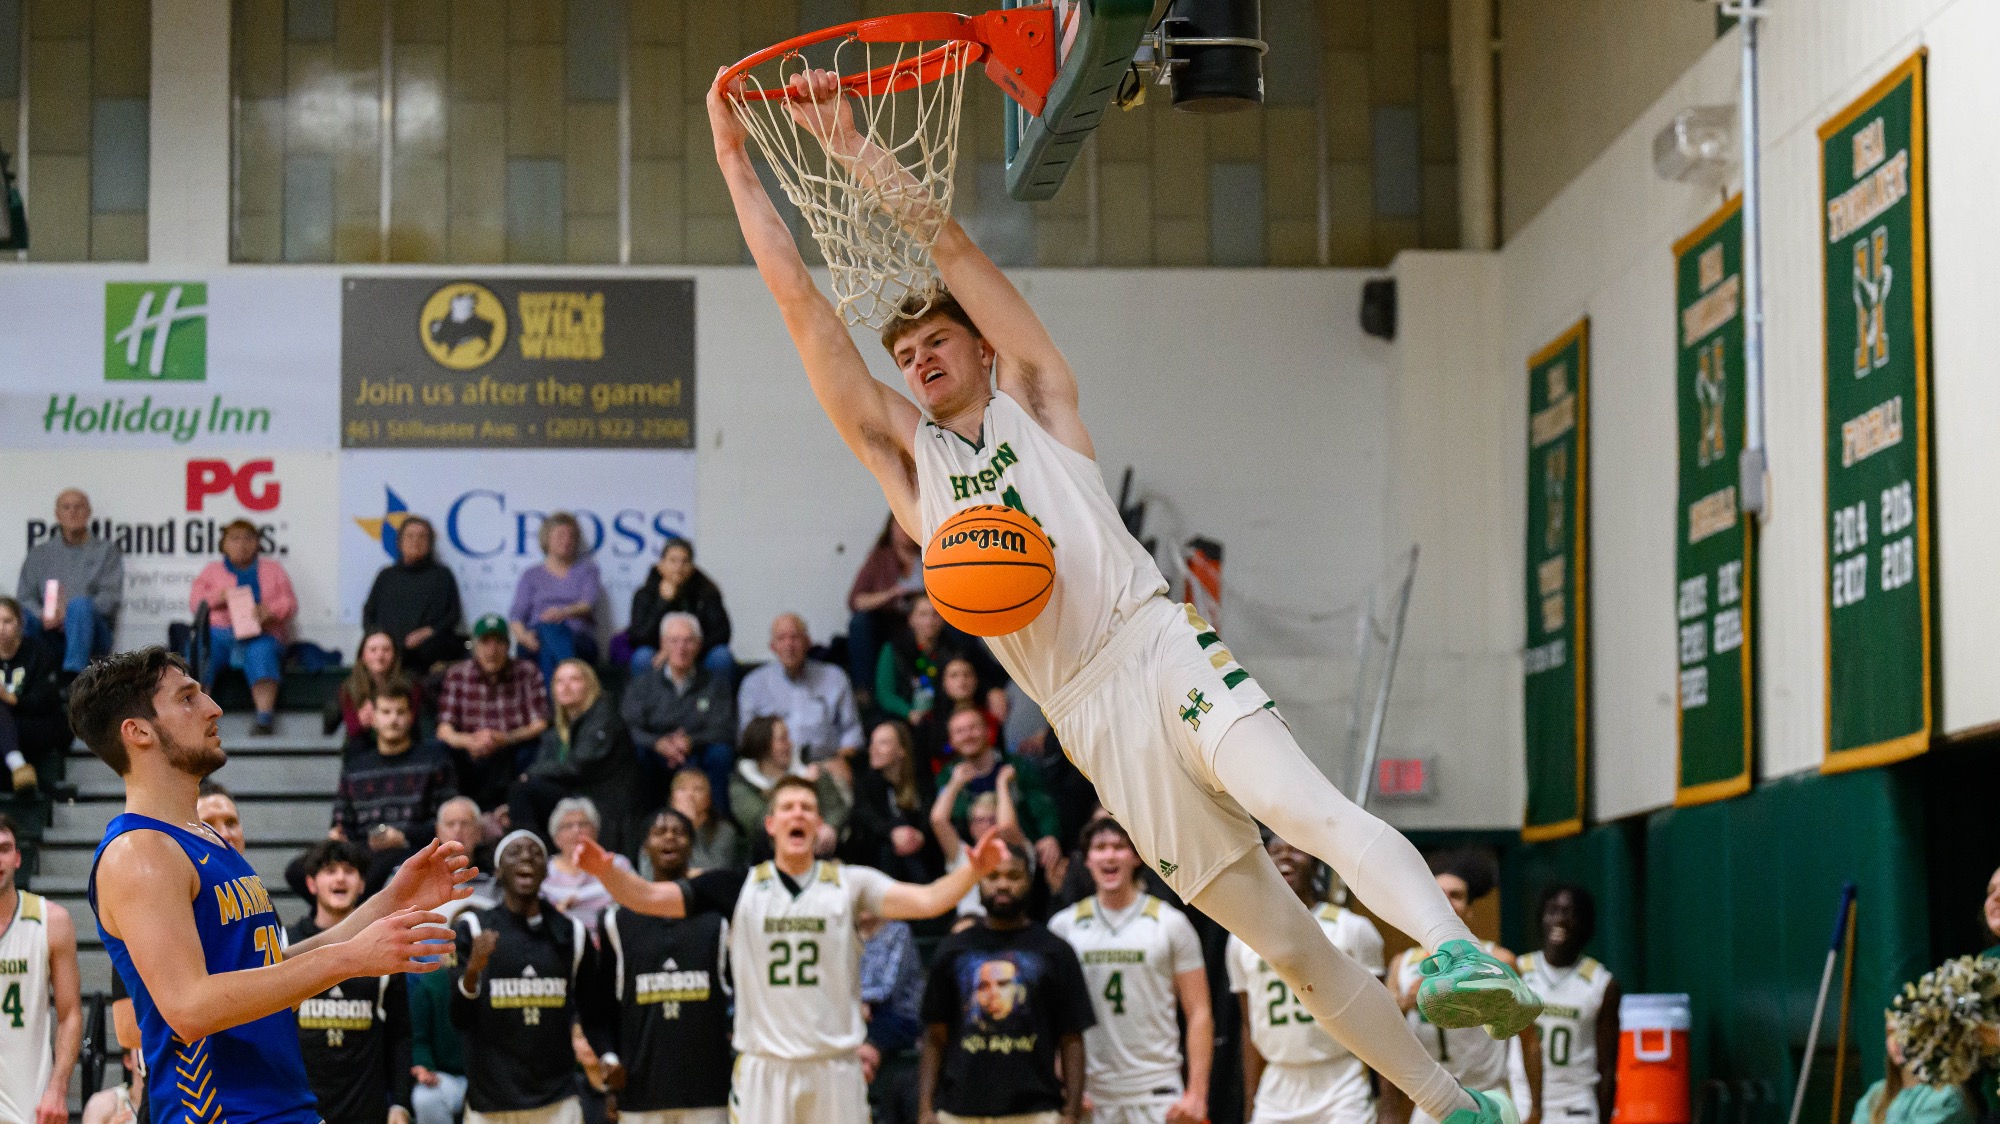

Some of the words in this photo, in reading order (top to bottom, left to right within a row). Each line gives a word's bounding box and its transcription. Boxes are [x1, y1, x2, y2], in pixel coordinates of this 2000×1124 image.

[355, 377, 413, 406] Join
[421, 383, 455, 404] us
[460, 376, 527, 404] after
[536, 377, 583, 404] the
[590, 378, 682, 413] game!
[43, 393, 202, 443] Holiday
[207, 394, 271, 433] Inn
[185, 458, 282, 513] PG
[26, 517, 176, 555] Ptland
[185, 518, 289, 556] Gls.
[941, 528, 1028, 555] Wilson
[768, 940, 819, 987] 22
[2, 982, 25, 1029] 4
[1103, 970, 1125, 1015] 4
